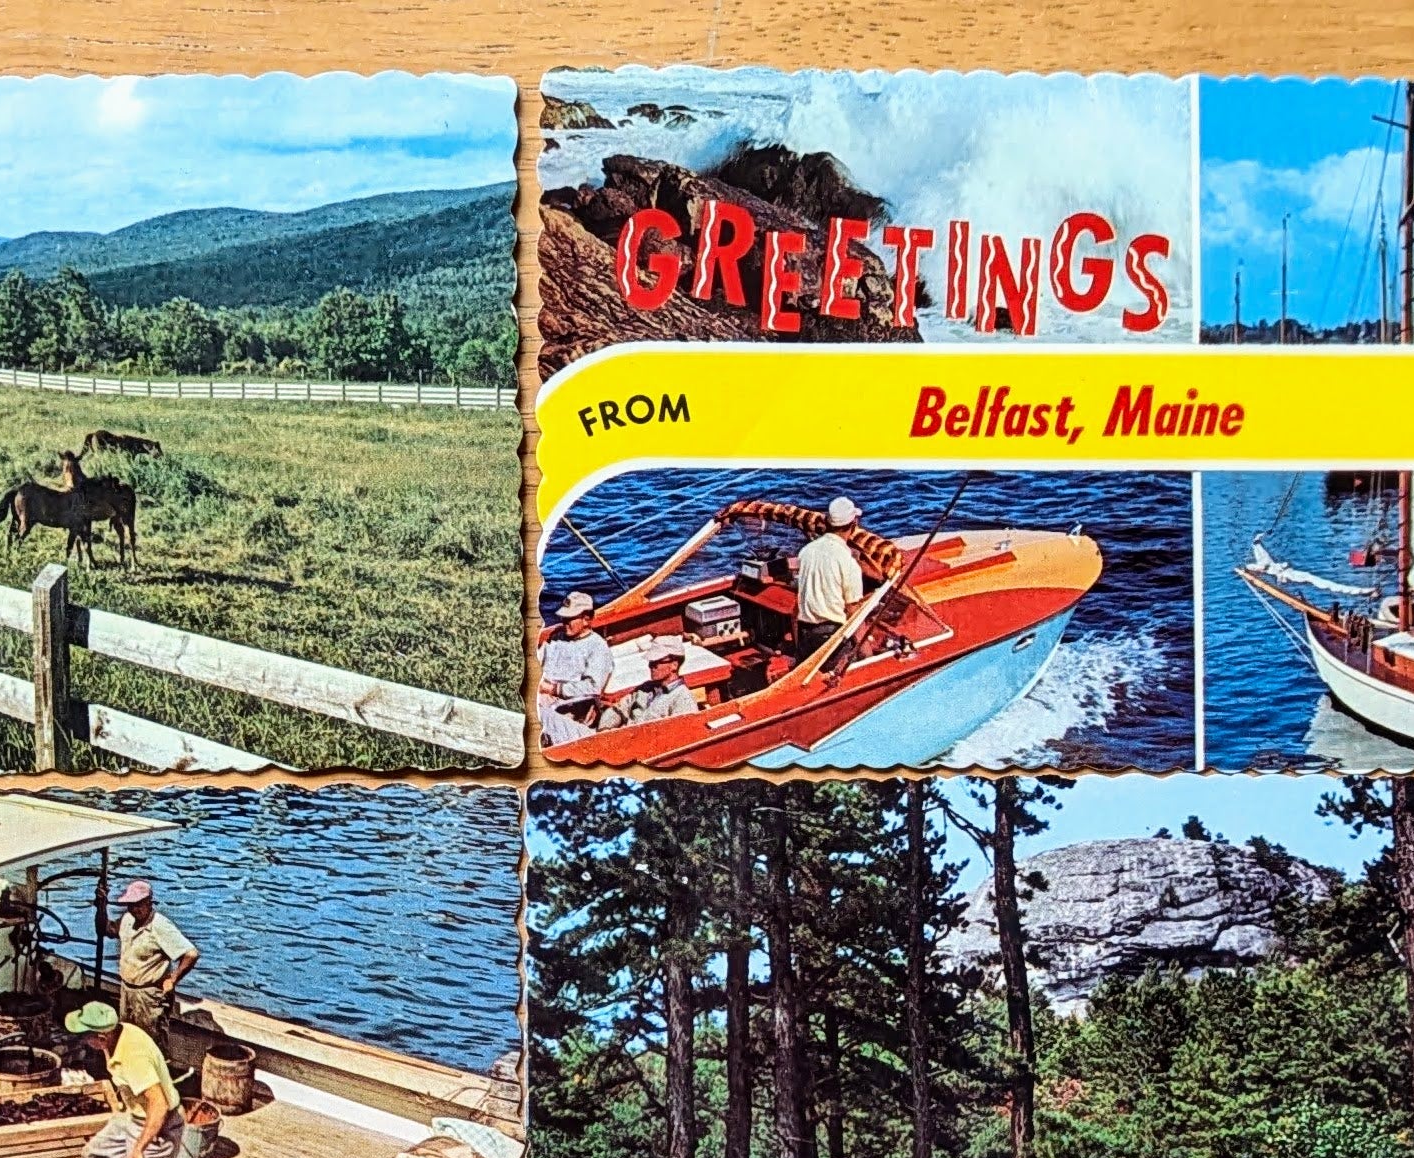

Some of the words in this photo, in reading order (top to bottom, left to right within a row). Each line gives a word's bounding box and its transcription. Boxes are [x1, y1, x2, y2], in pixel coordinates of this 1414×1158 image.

[616, 199, 1171, 337] GREETINGS
[577, 393, 691, 437] FROM
[909, 385, 1084, 445] Belfast,
[1102, 385, 1245, 437] Maine
